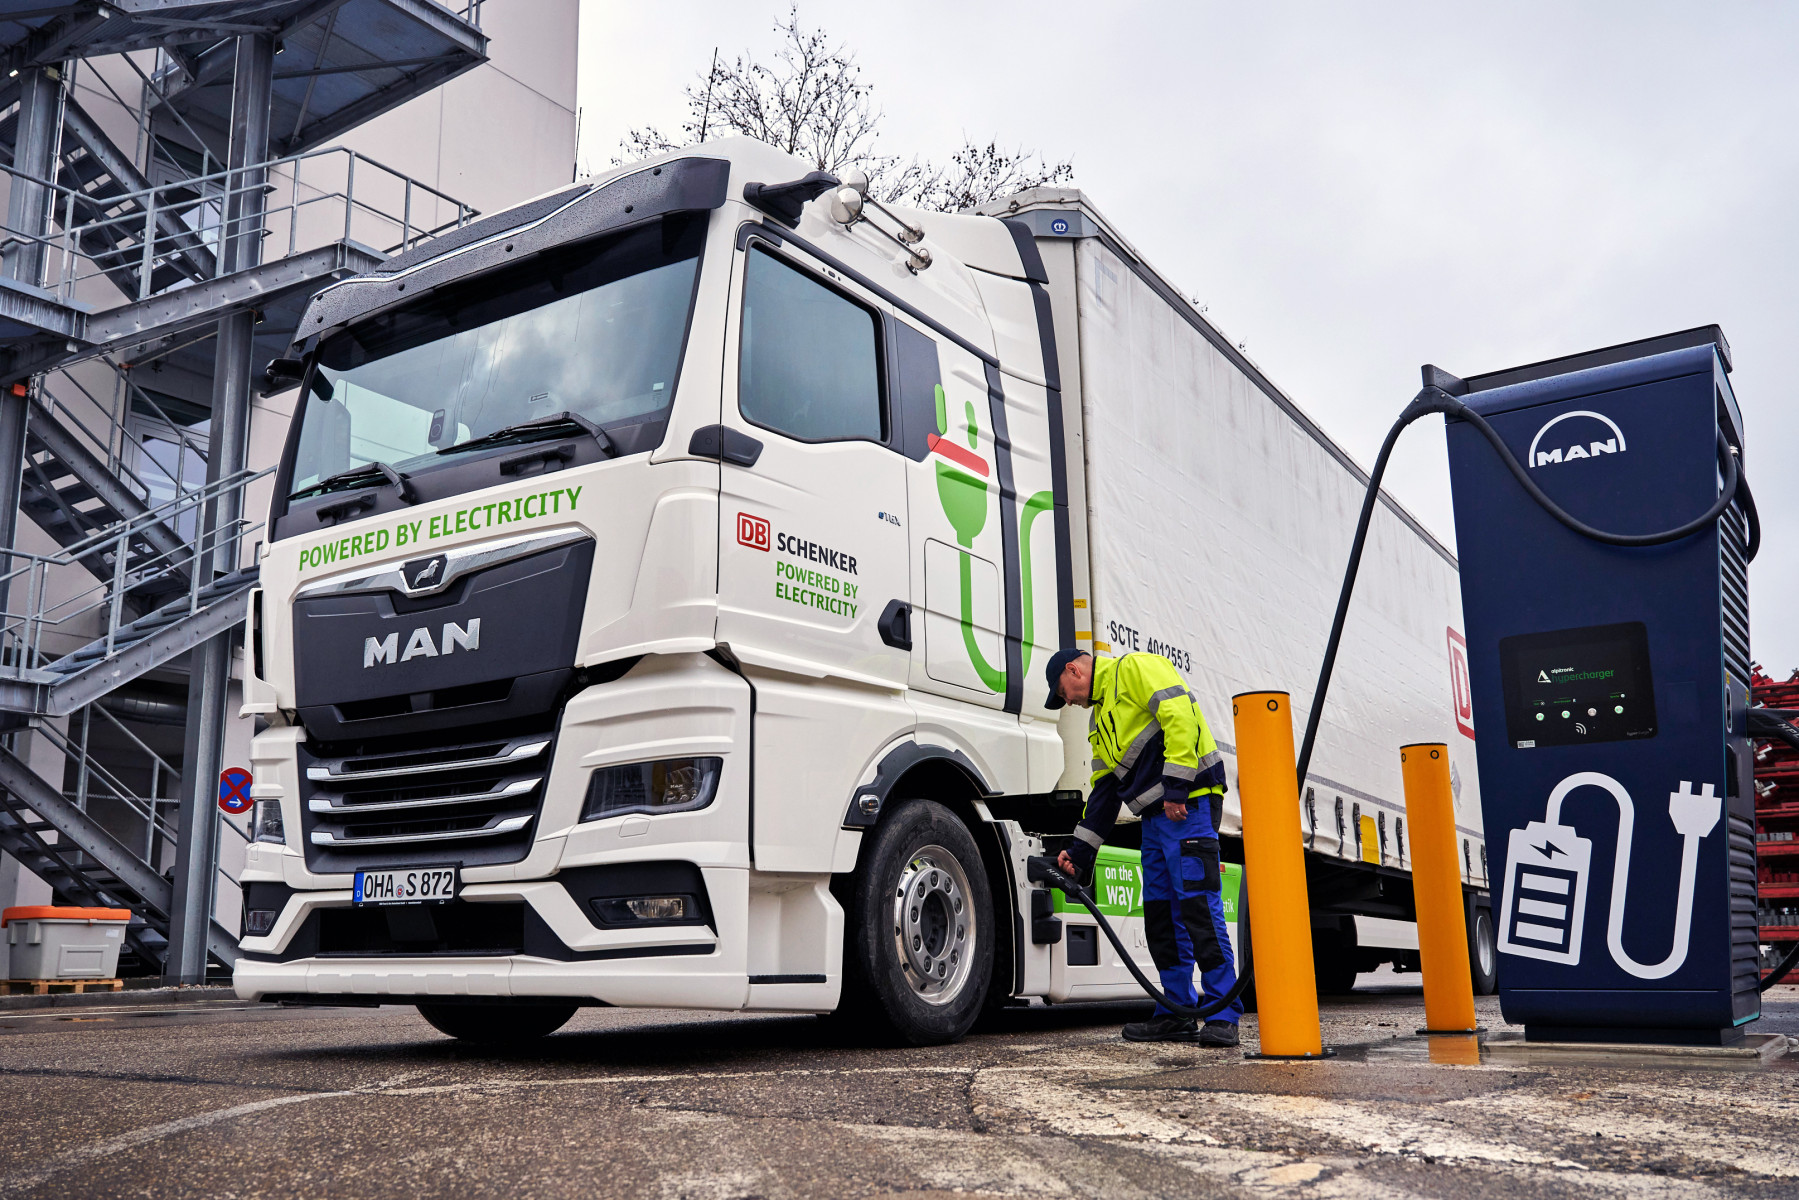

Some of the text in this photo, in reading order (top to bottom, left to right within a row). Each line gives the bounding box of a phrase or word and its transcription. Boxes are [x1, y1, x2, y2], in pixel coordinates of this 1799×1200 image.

[1536, 438, 1617, 466] MAN
[299, 486, 583, 571] POWERED BY ELECTRICITY
[741, 517, 858, 576] DB SCHENKER
[776, 561, 859, 599] POWERED BY
[775, 582, 858, 619] ELECTRICITY
[363, 618, 481, 668] MAN
[1110, 620, 1140, 652] SCTE
[1551, 670, 1614, 684] hypercharger
[364, 874, 394, 898] OHA
[406, 873, 417, 897] S
[420, 871, 453, 896] 872
[1105, 865, 1133, 882] on the
[1106, 884, 1134, 912] way
